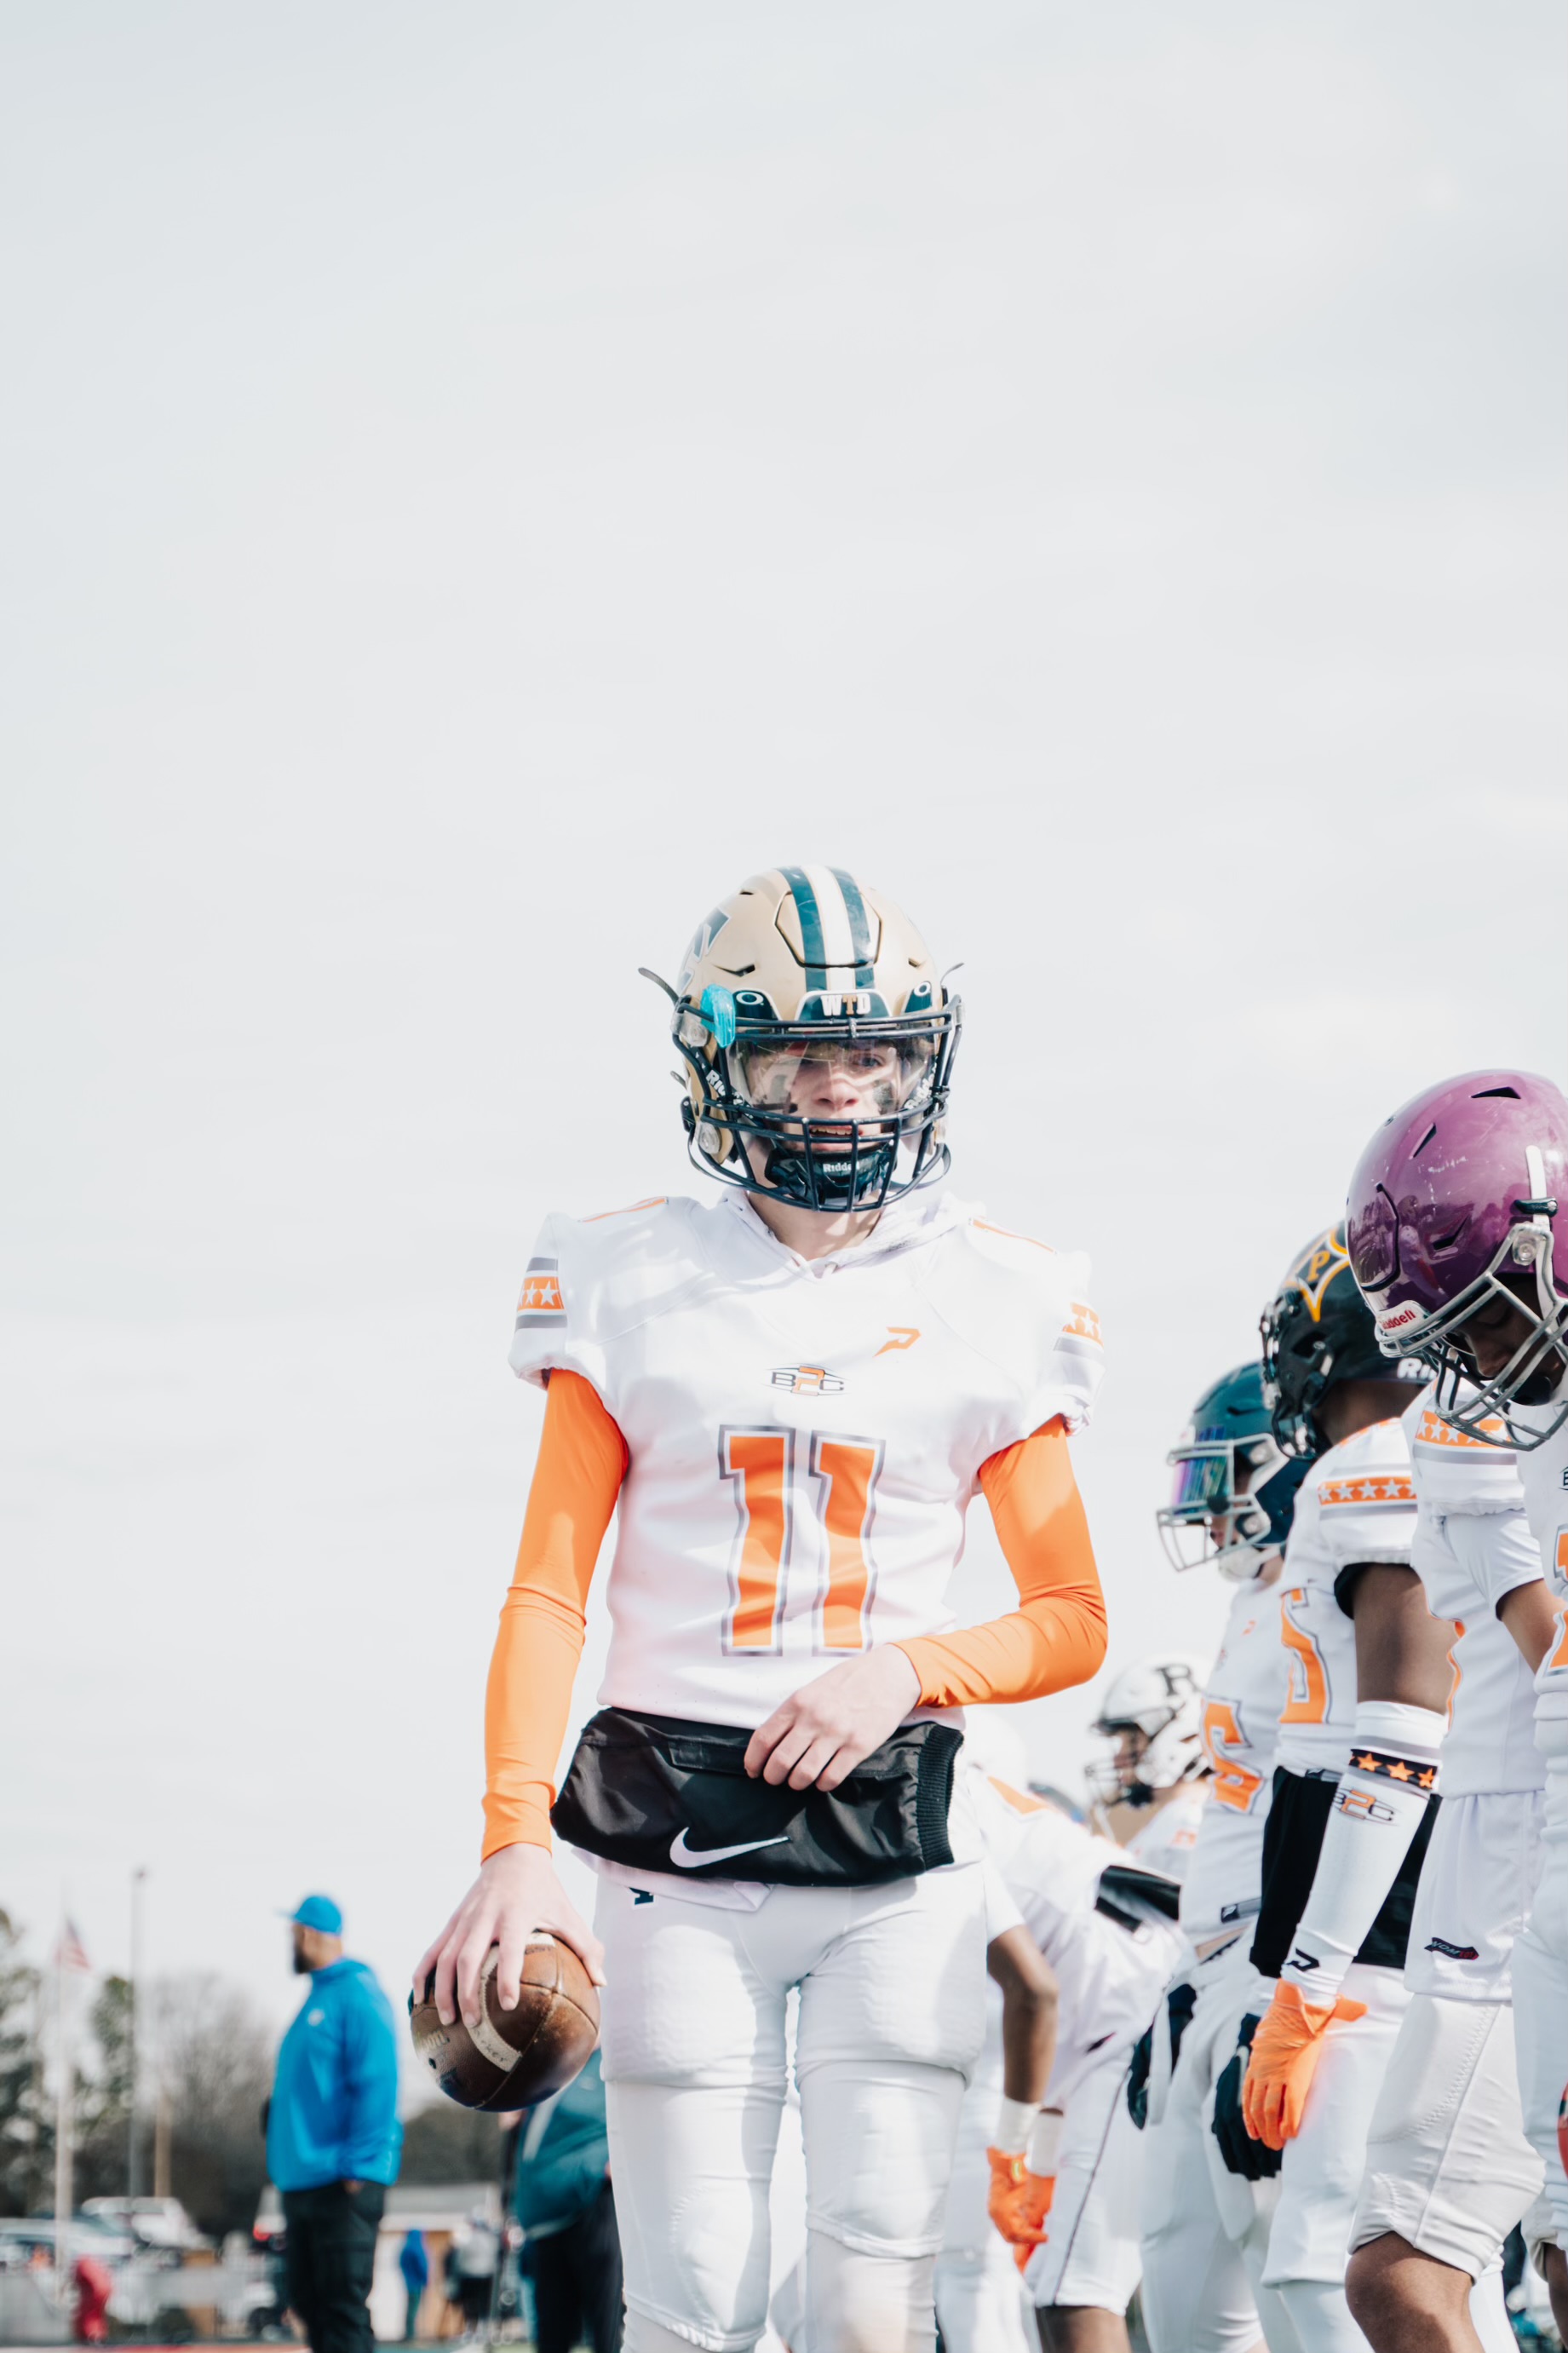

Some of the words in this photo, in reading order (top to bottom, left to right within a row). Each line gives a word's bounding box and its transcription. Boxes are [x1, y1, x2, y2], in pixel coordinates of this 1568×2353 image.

[820, 992, 871, 1016] WTD
[1307, 1249, 1331, 1282] P
[771, 1365, 845, 1396] B2C
[718, 1424, 886, 1657] 11
[1153, 1663, 1203, 1696] R
